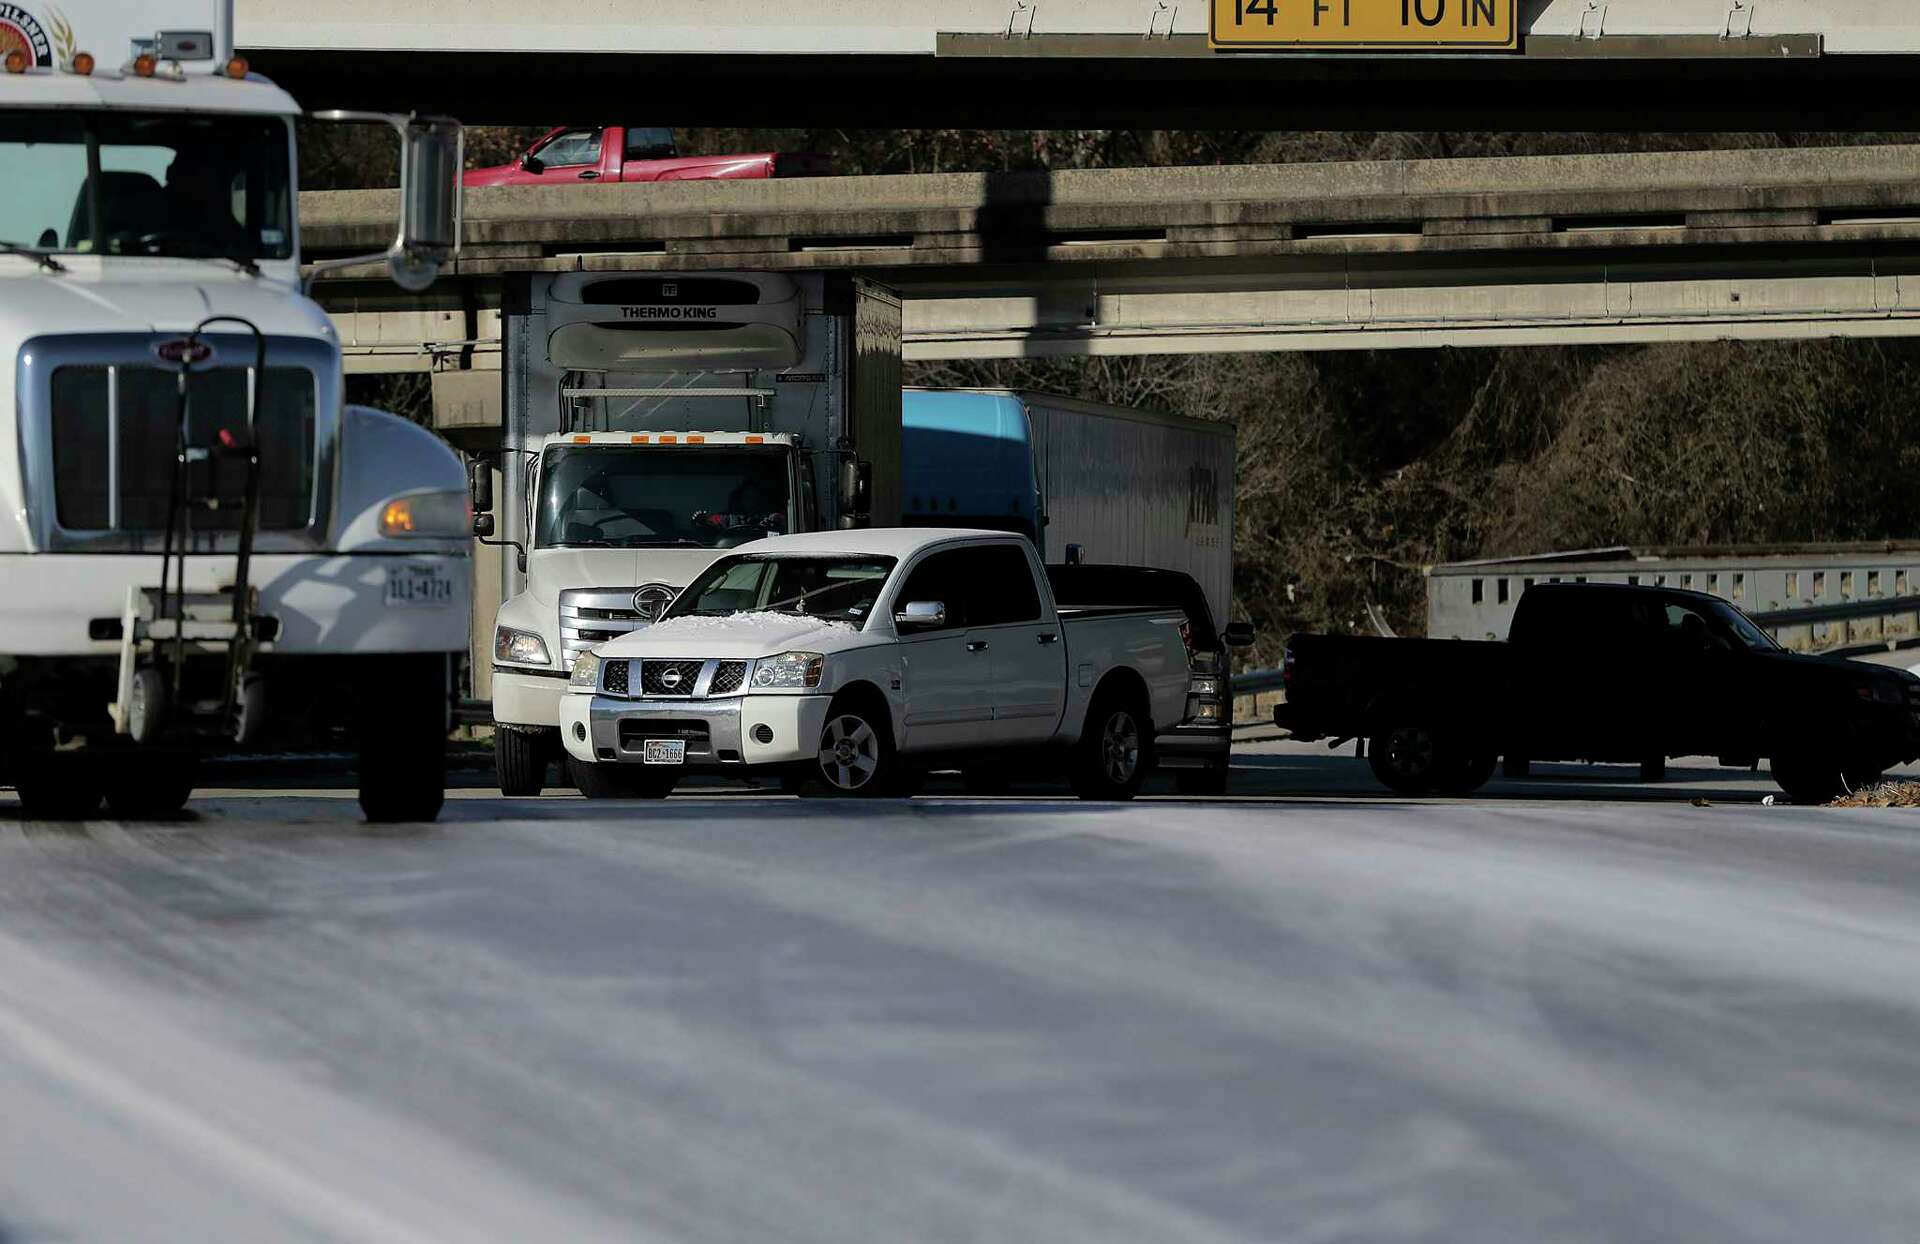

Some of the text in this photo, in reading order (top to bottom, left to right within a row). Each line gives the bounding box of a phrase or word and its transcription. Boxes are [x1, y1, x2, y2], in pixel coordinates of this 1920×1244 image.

[1235, 0, 1278, 26] 14
[1402, 0, 1444, 26] 10
[1461, 0, 1495, 27] IN
[621, 307, 717, 318] THERMO KING
